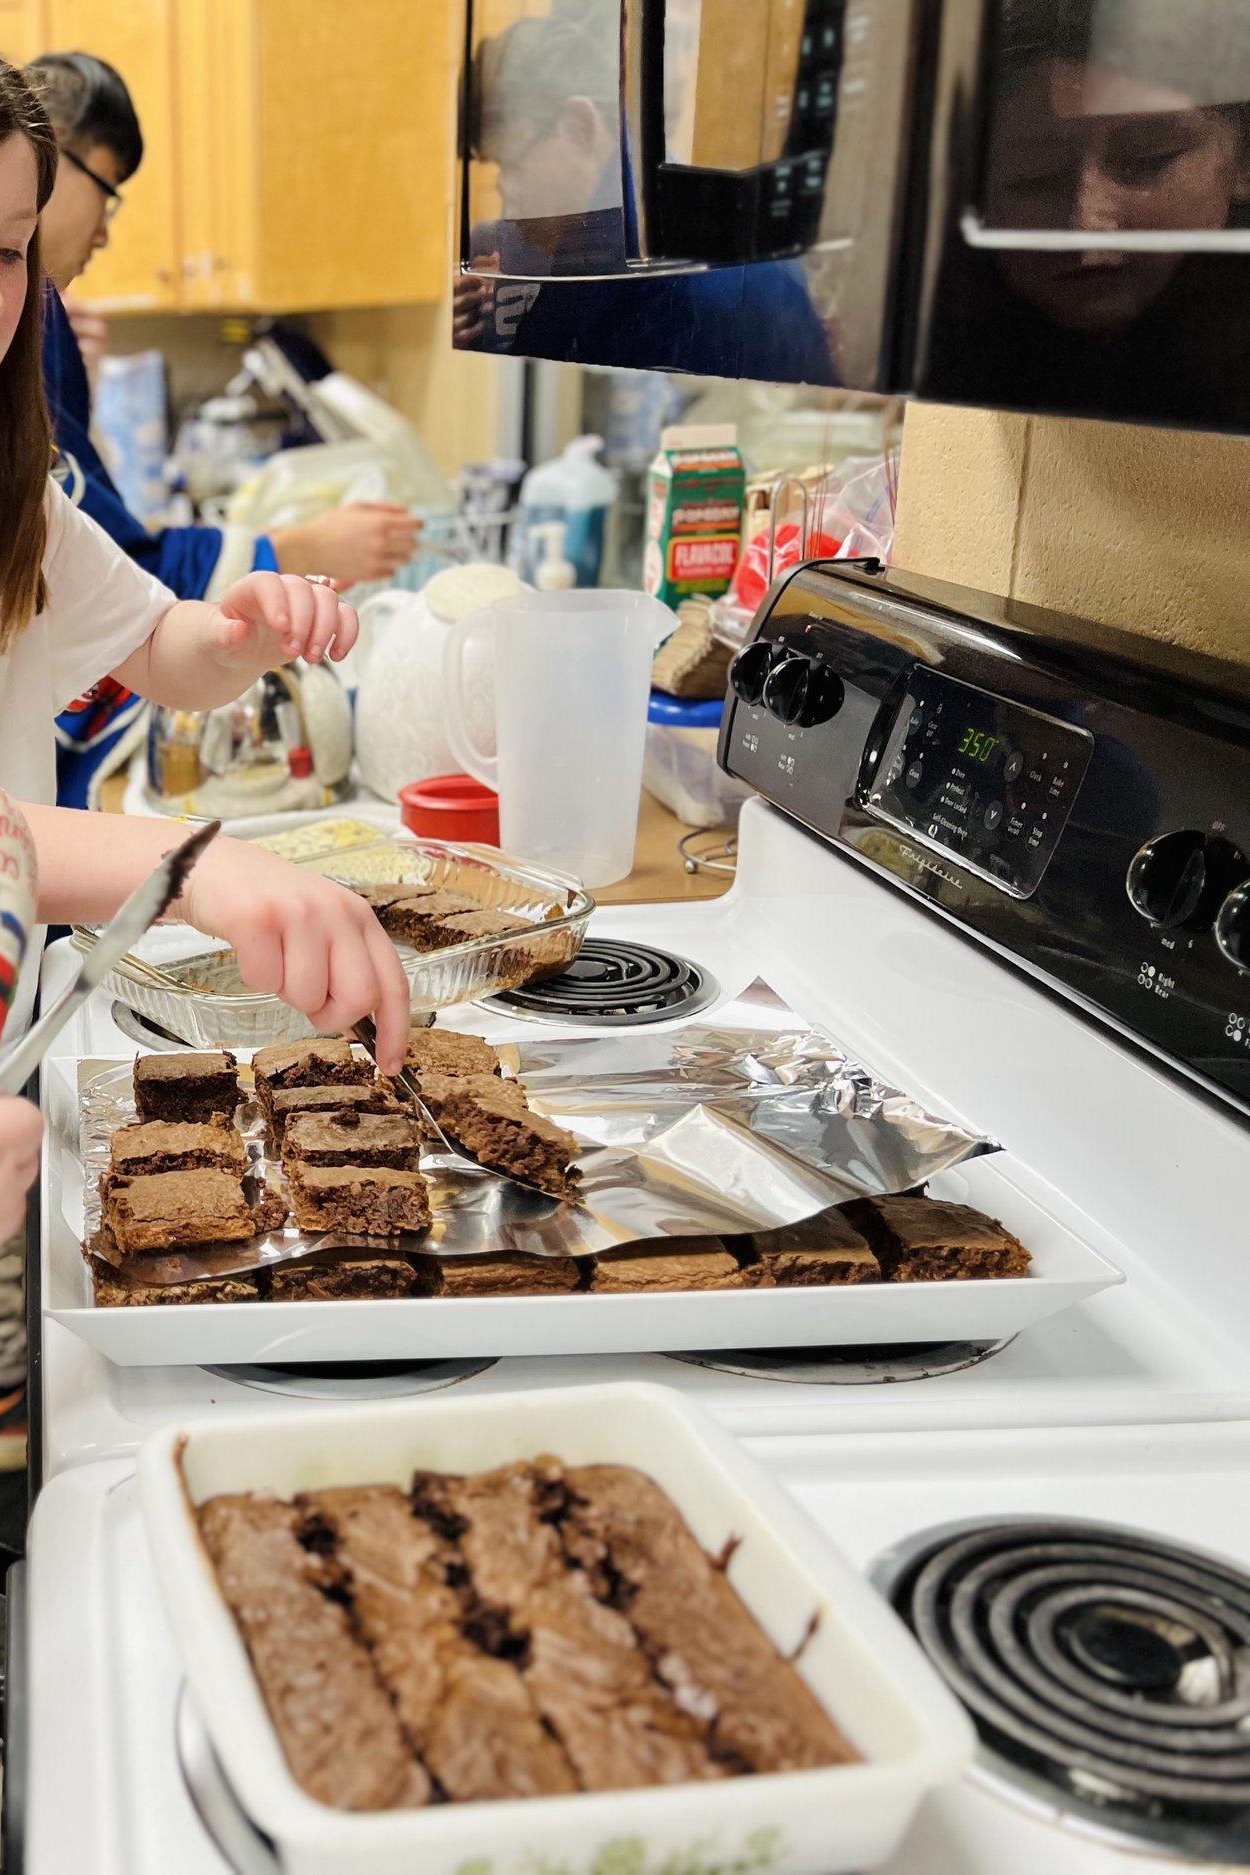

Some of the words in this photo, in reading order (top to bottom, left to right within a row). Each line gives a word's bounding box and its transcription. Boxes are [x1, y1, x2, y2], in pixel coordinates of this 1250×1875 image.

[899, 844, 963, 889] Frigidaire
[1158, 973, 1175, 988] Right
[1154, 985, 1169, 999] Rear
